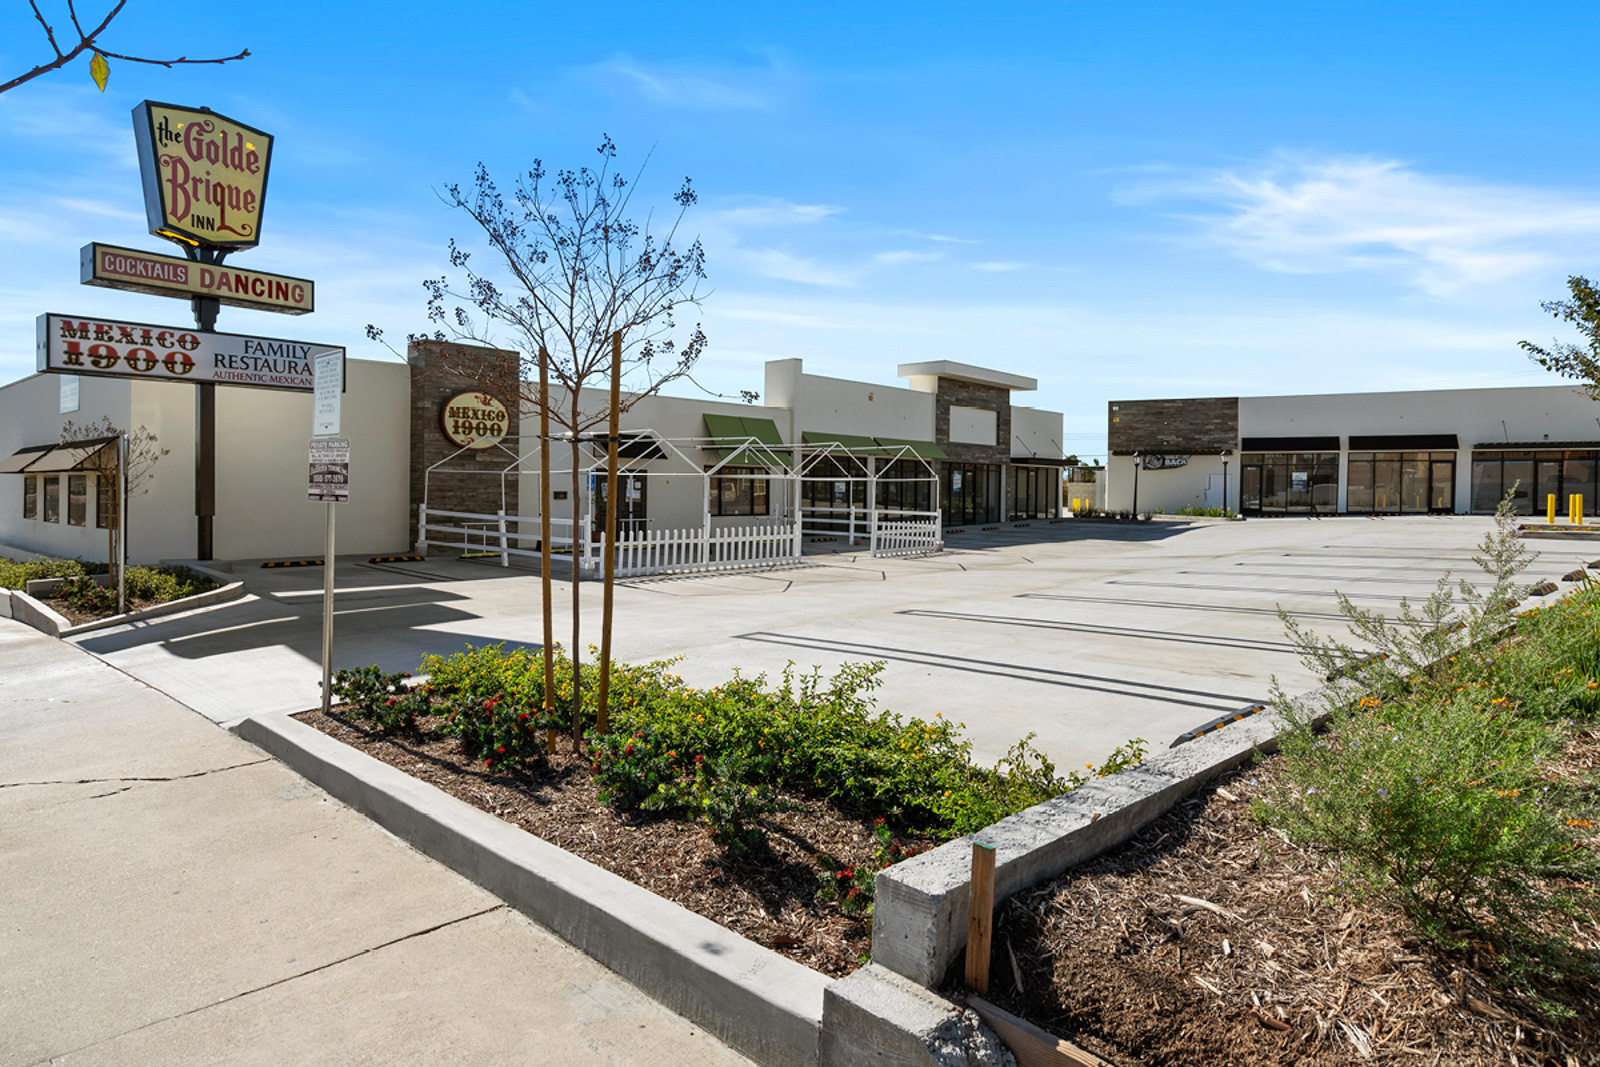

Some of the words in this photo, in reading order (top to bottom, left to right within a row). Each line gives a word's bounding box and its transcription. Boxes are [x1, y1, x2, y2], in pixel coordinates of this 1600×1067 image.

[156, 115, 183, 148] the
[184, 119, 260, 175] Golde
[158, 153, 257, 237] Brique
[190, 213, 216, 232] INN
[103, 254, 188, 283] COCKTAILS
[199, 268, 305, 304] DANCING
[59, 319, 201, 351] MEXICO
[61, 340, 196, 375] 1900
[244, 339, 312, 360] FAMILY
[213, 352, 314, 376] RESTAURA
[212, 370, 268, 384] AUTHENTIC
[270, 374, 313, 386] MEXICAN
[448, 406, 506, 422] MEXICO
[452, 419, 503, 437] 1900
